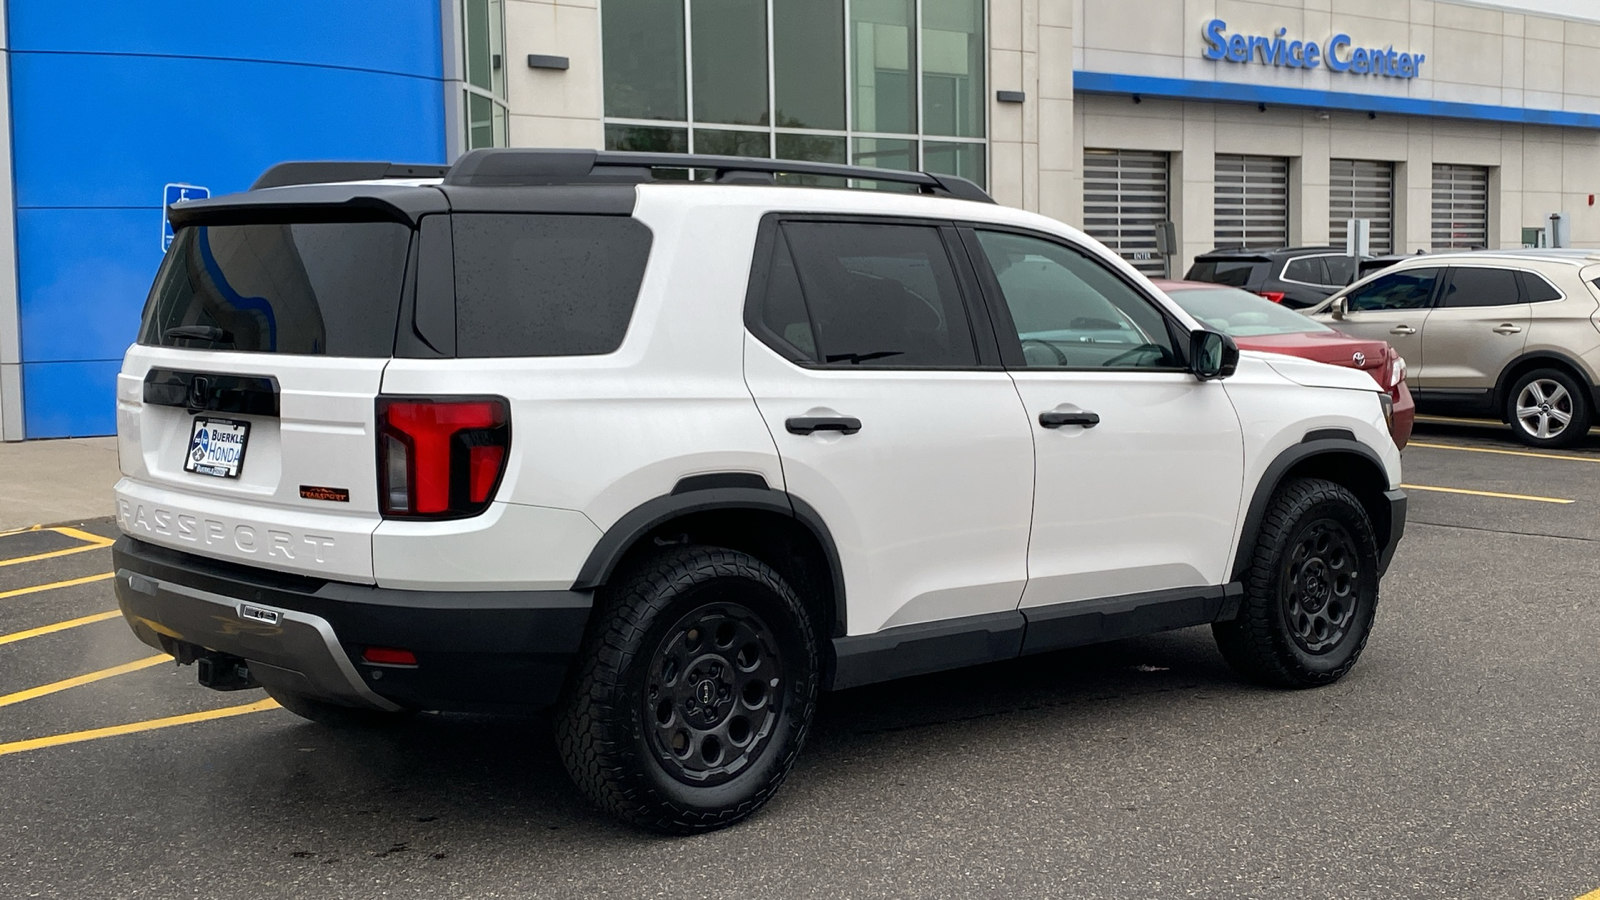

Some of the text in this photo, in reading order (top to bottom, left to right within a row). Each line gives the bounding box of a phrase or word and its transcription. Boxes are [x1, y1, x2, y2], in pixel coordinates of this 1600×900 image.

[1201, 19, 1426, 79] Service Center
[211, 429, 244, 444] BUERKLE
[207, 442, 240, 463] HONDA
[301, 491, 347, 500] TRAILSPORT
[117, 498, 335, 563] PASSPORT
